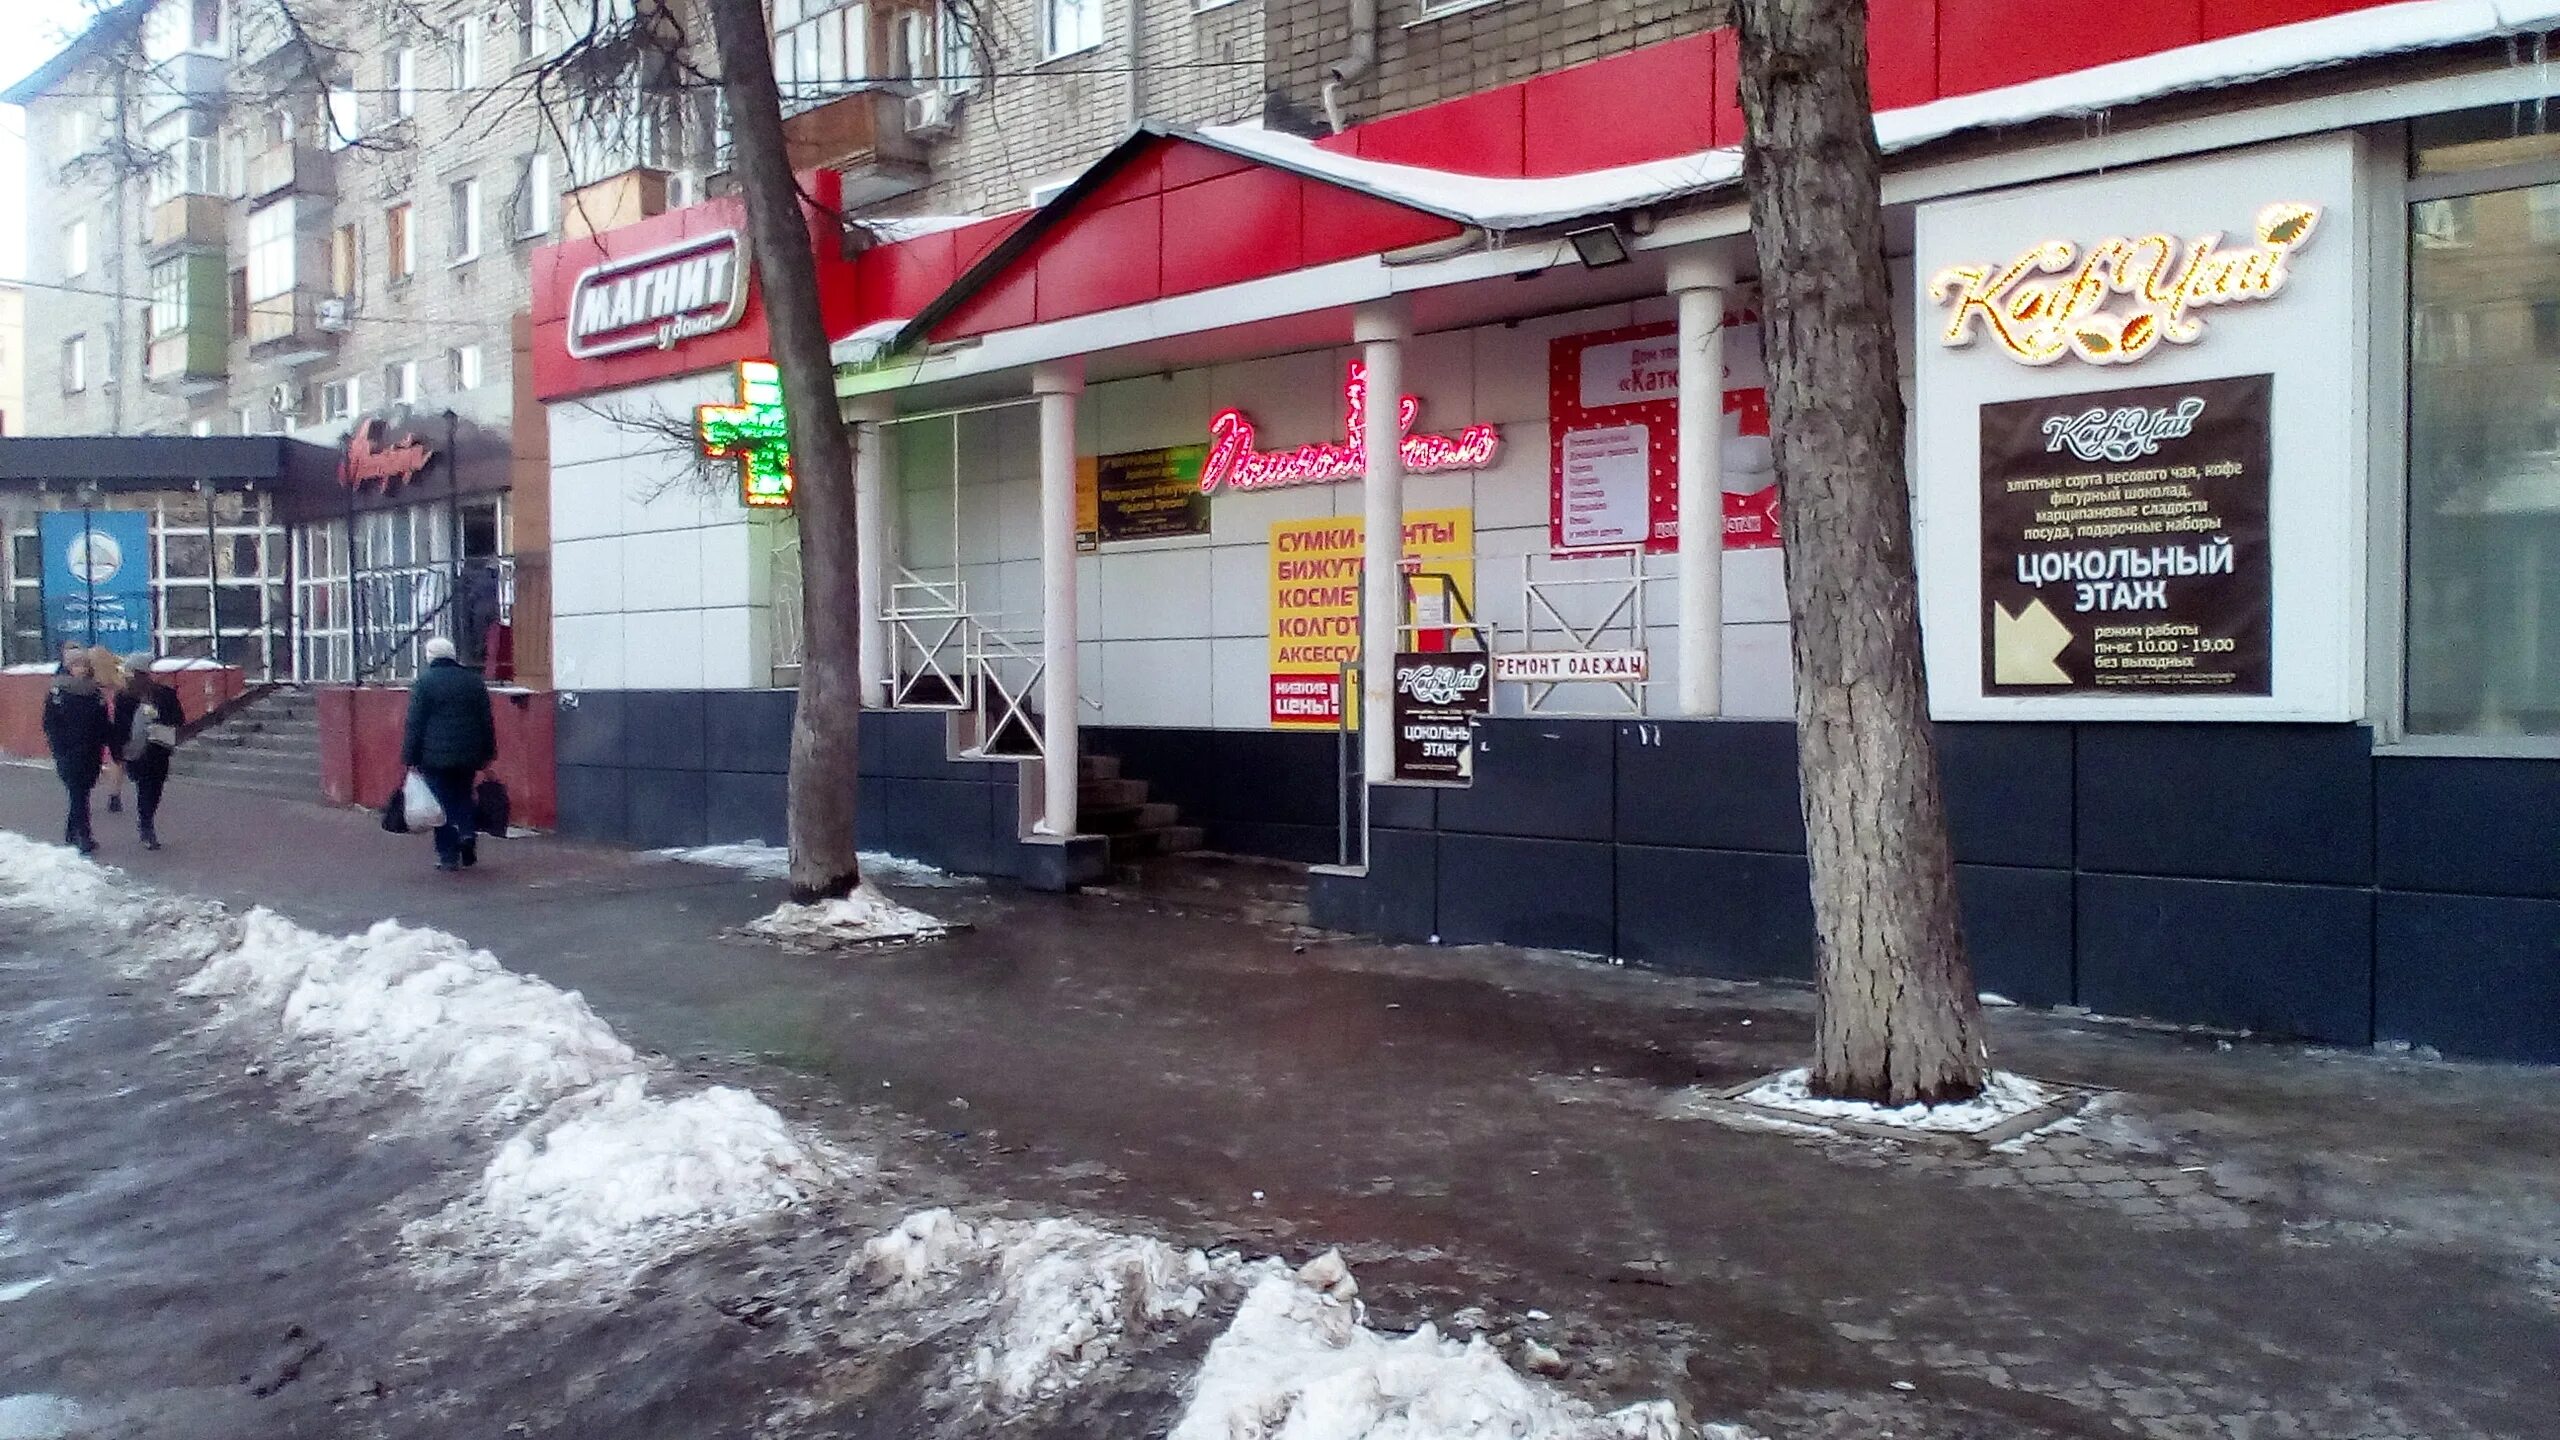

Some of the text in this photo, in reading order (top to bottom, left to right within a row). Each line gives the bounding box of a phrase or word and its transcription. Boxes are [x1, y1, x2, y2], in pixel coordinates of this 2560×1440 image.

[578, 252, 731, 337] МАГНИТ
[673, 313, 713, 341] дома
[2065, 474, 2102, 490] сорта
[2106, 468, 2167, 485] весового
[2171, 464, 2201, 481] чая,
[2204, 460, 2243, 480] кофе
[2050, 486, 2120, 508] фигурный
[2036, 500, 2209, 526] марципановые сладости
[1278, 528, 1355, 553] СУМКИ
[2024, 516, 2221, 542] посуда, подарочные наборы
[2016, 537, 2234, 588] ЦОКОЛЬНЫЙ
[2074, 580, 2168, 612] ЭТАЖ
[2095, 623, 2198, 641] режим работы
[2094, 642, 2134, 654] пн-вс
[2137, 640, 2178, 653] 10.00
[1497, 656, 1641, 674] РЕМОНТ ОДЕЖДЫ
[2095, 656, 2195, 670] без выходных
[1422, 743, 1457, 758] ЭТАЖ
